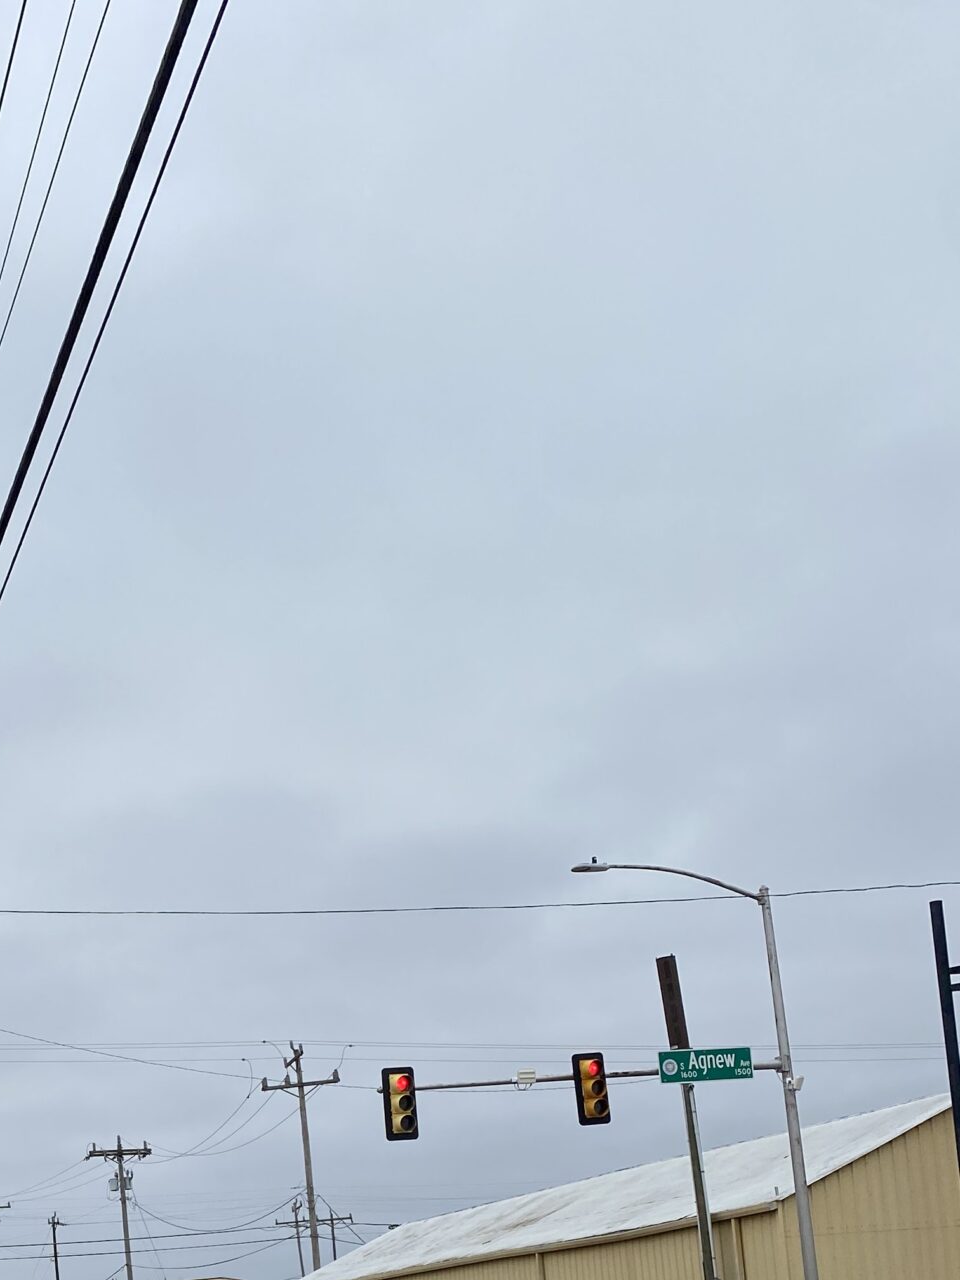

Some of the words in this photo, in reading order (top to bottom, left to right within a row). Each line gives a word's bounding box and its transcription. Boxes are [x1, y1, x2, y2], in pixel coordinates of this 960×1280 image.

[680, 1062, 685, 1070] S
[688, 1052, 735, 1075] Agnew
[680, 1070, 698, 1078] 1600
[734, 1068, 752, 1076] 1500
